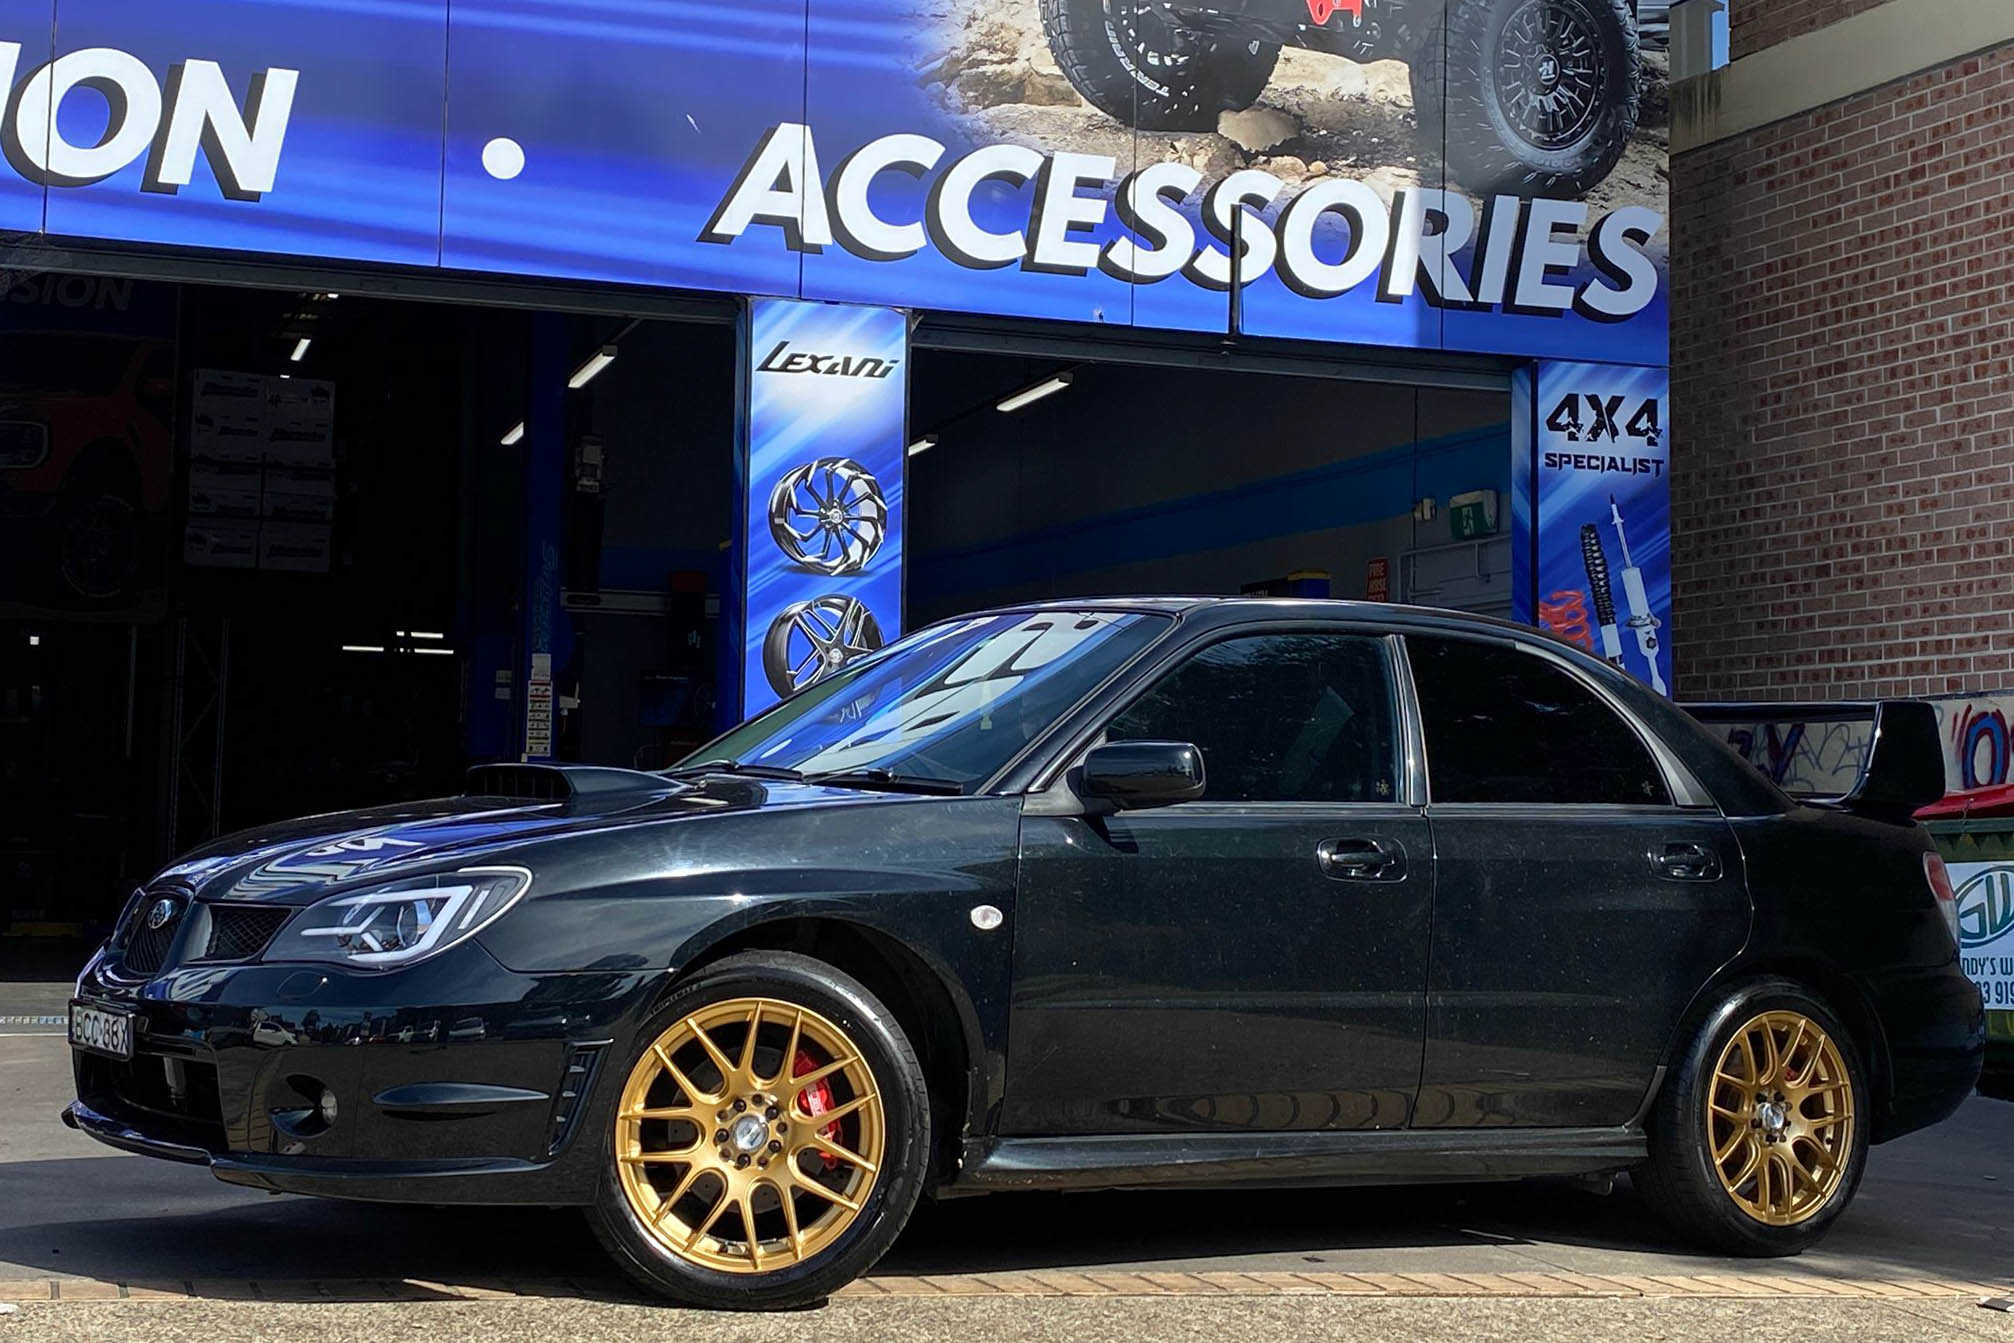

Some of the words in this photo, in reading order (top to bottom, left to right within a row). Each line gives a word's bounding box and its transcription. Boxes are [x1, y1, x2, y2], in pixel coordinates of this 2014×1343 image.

[0, 40, 299, 203] ON
[696, 121, 1662, 323] ACCESSORIES
[1545, 392, 1663, 447] 4X4
[1544, 452, 1665, 478] SPECIALIST
[1962, 956, 1997, 976] NDY'S
